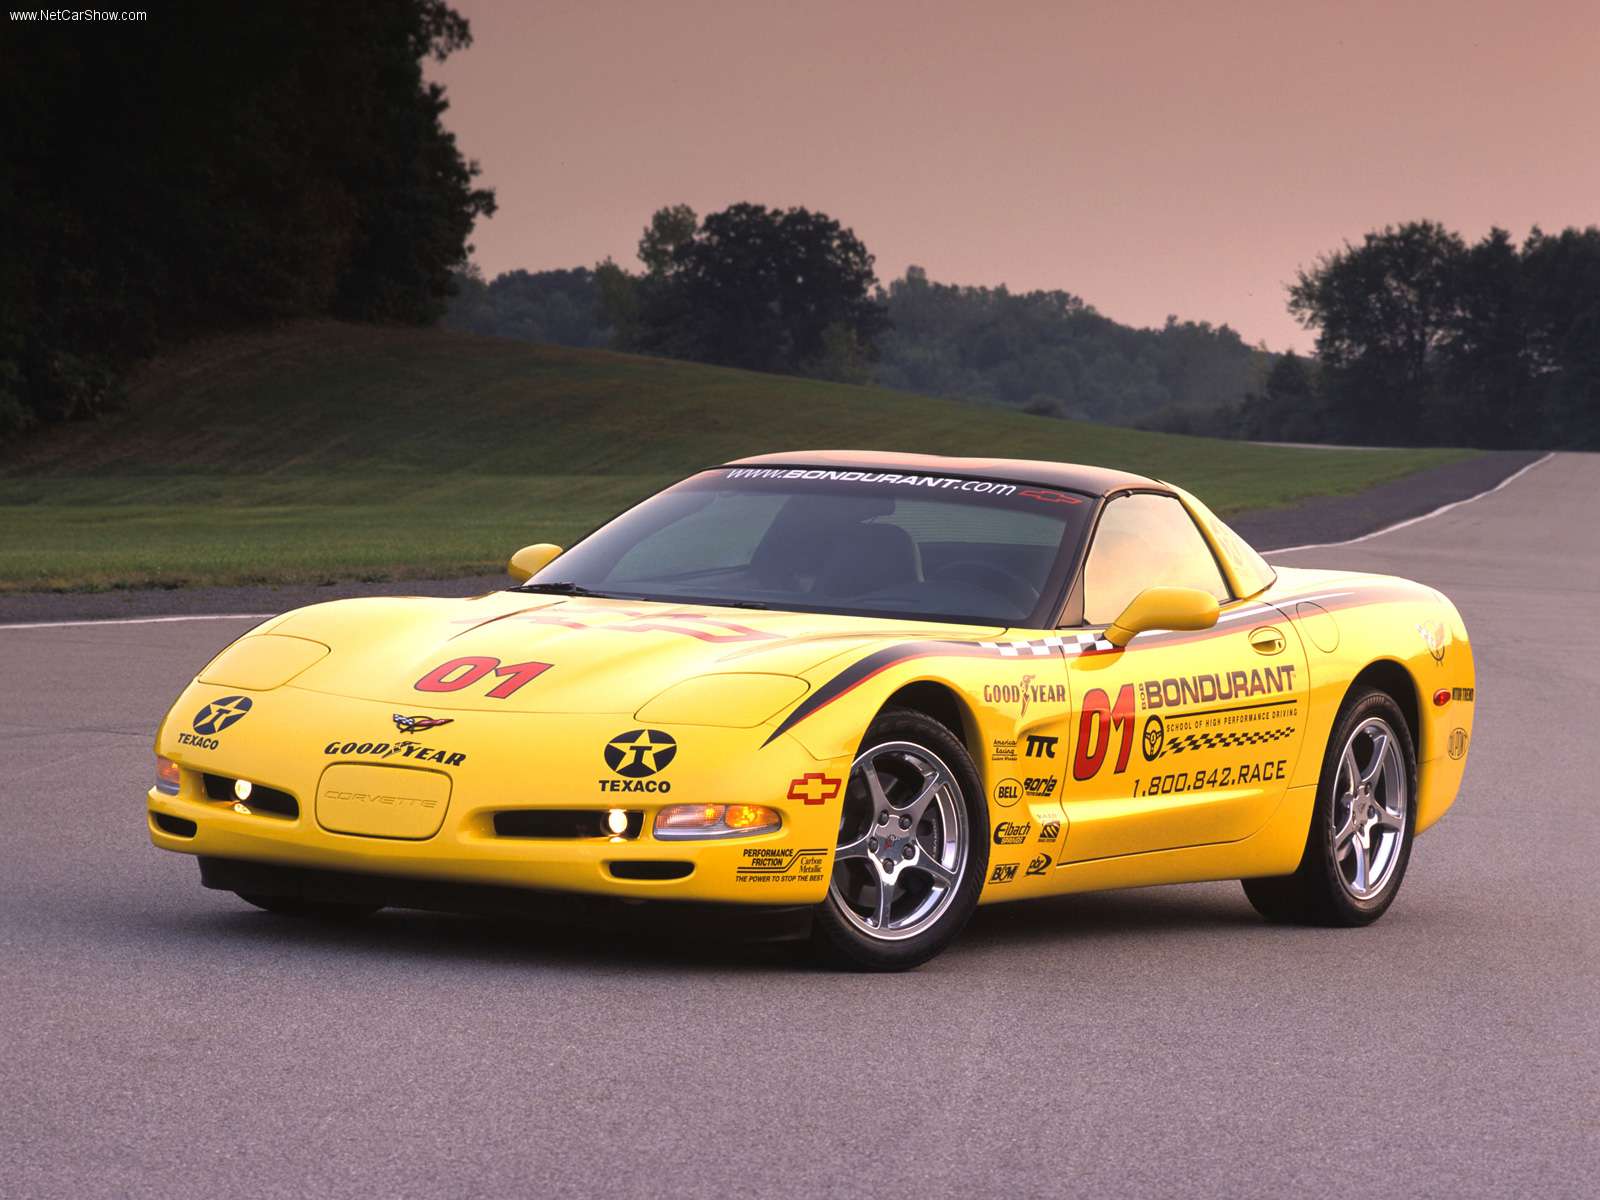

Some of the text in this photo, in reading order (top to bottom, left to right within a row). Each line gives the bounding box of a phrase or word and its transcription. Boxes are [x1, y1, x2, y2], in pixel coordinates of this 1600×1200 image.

[726, 467, 1017, 496] www.BONDURANT.com
[413, 655, 555, 700] 01
[1145, 664, 1295, 710] BONDURANT
[1166, 708, 1298, 733] SCHOOL OF HIGH PERFORMANCE DRIVING
[178, 732, 219, 751] TEXACO
[1072, 682, 1136, 782] 01
[598, 779, 671, 794] TEXACO
[1132, 759, 1288, 799] 1.800.842.RACE
[323, 790, 440, 809] CORVETTE
[998, 786, 1018, 799] BELL
[743, 848, 794, 857] PERFORMANCE
[751, 858, 783, 866] FRICTION
